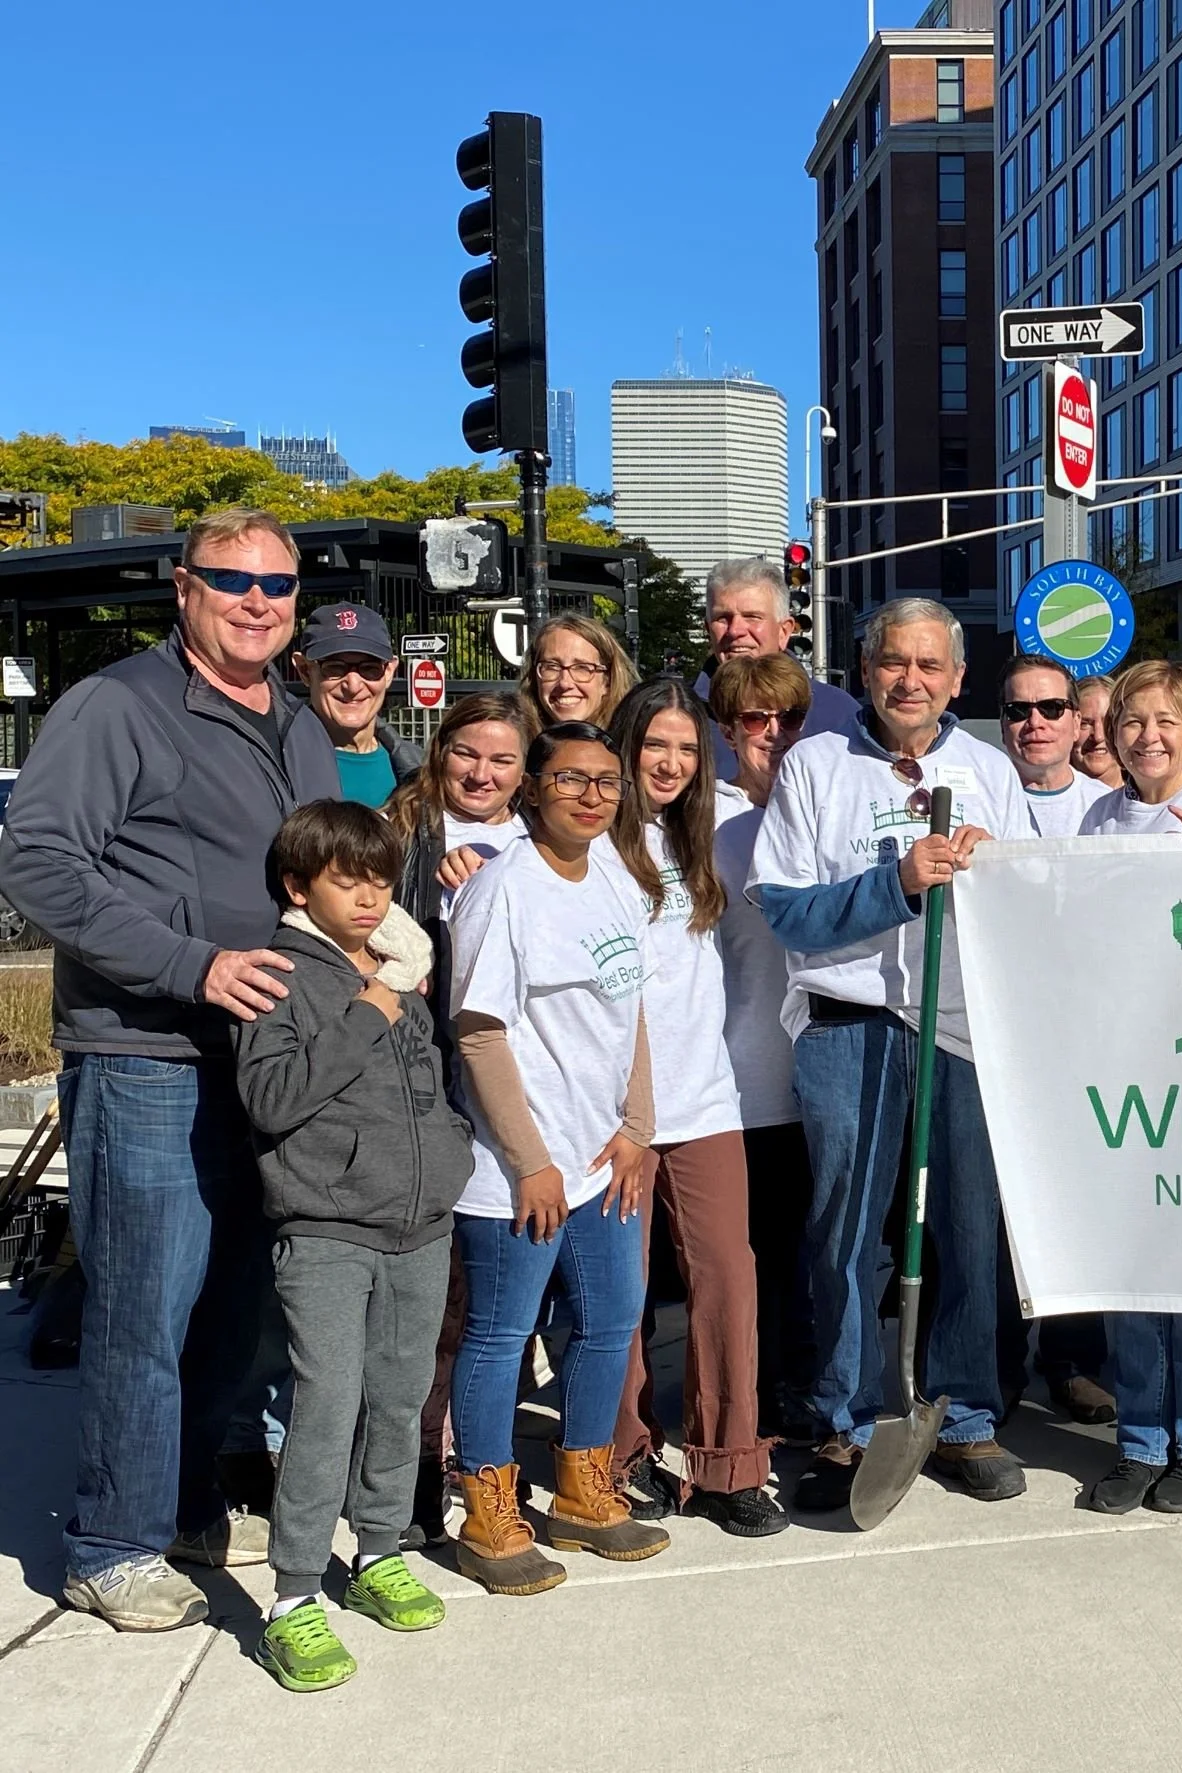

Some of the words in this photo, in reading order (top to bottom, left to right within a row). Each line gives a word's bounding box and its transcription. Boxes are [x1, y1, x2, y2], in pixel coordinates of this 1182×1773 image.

[1018, 325, 1054, 344] ONE
[1064, 322, 1102, 341] WAY
[1062, 396, 1073, 416] DO
[1076, 403, 1090, 424] NOT
[1065, 442, 1088, 467] ENTER
[1029, 568, 1088, 600] SOUTH
[1094, 574, 1125, 602] BAY
[335, 609, 359, 631] B
[406, 640, 419, 649] ONE
[421, 640, 436, 649] WAY
[501, 613, 525, 656] T
[418, 669, 426, 678] DO
[426, 669, 437, 678] NOT
[420, 689, 437, 698] ENTER
[850, 836, 898, 855] West
